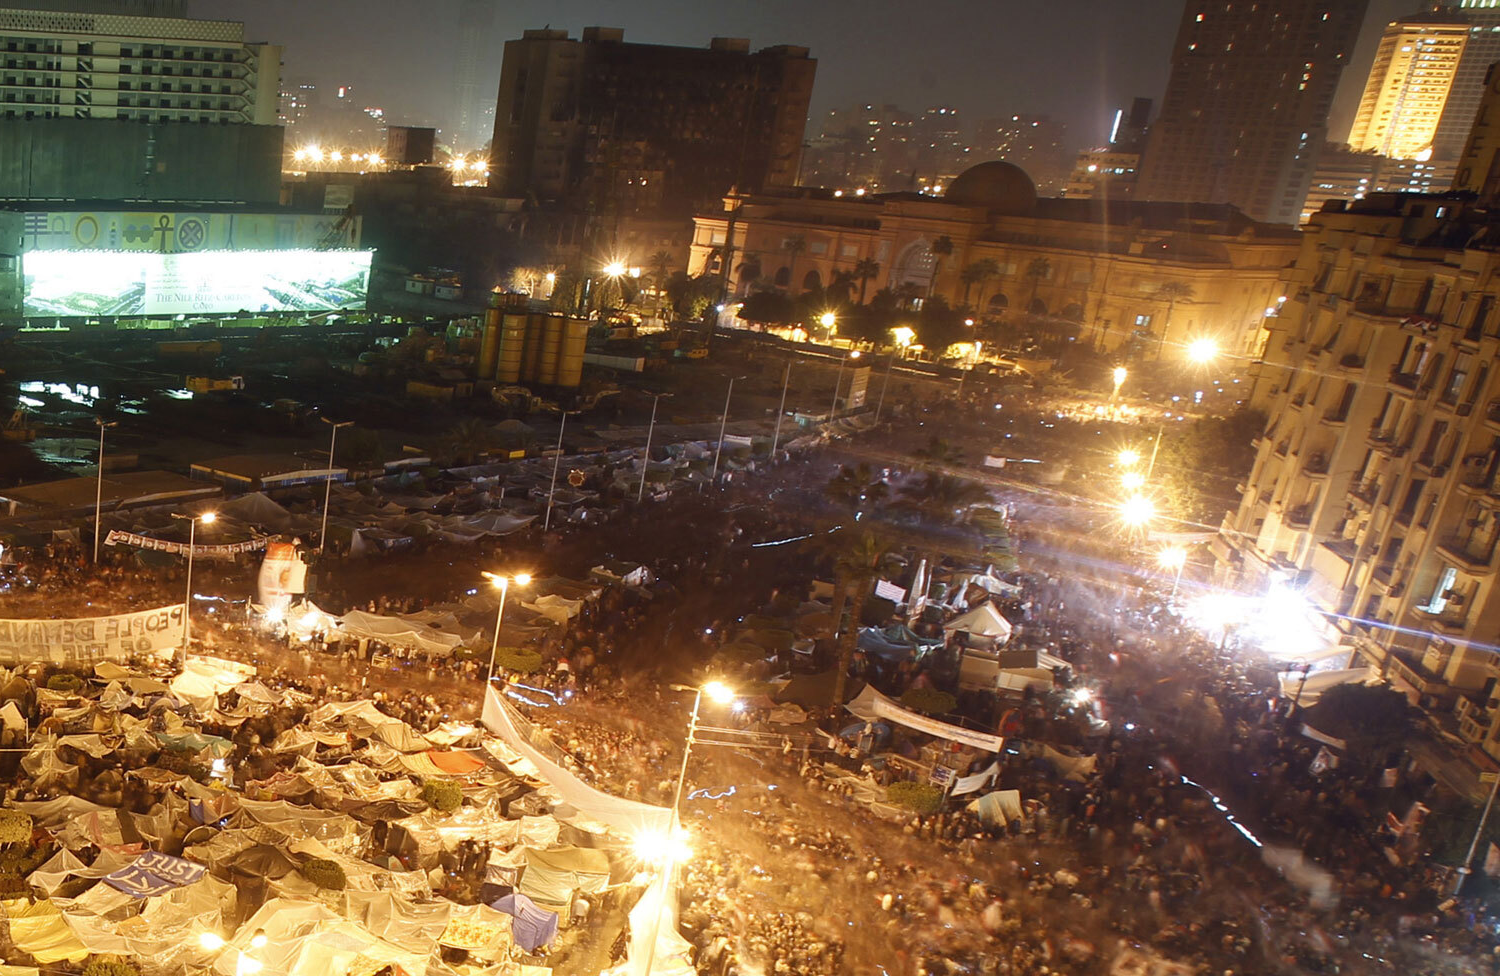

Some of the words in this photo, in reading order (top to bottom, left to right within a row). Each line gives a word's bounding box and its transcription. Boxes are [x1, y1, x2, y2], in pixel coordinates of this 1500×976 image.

[155, 293, 173, 303] THE
[175, 293, 193, 303] NILE
[139, 854, 206, 880] JUST
